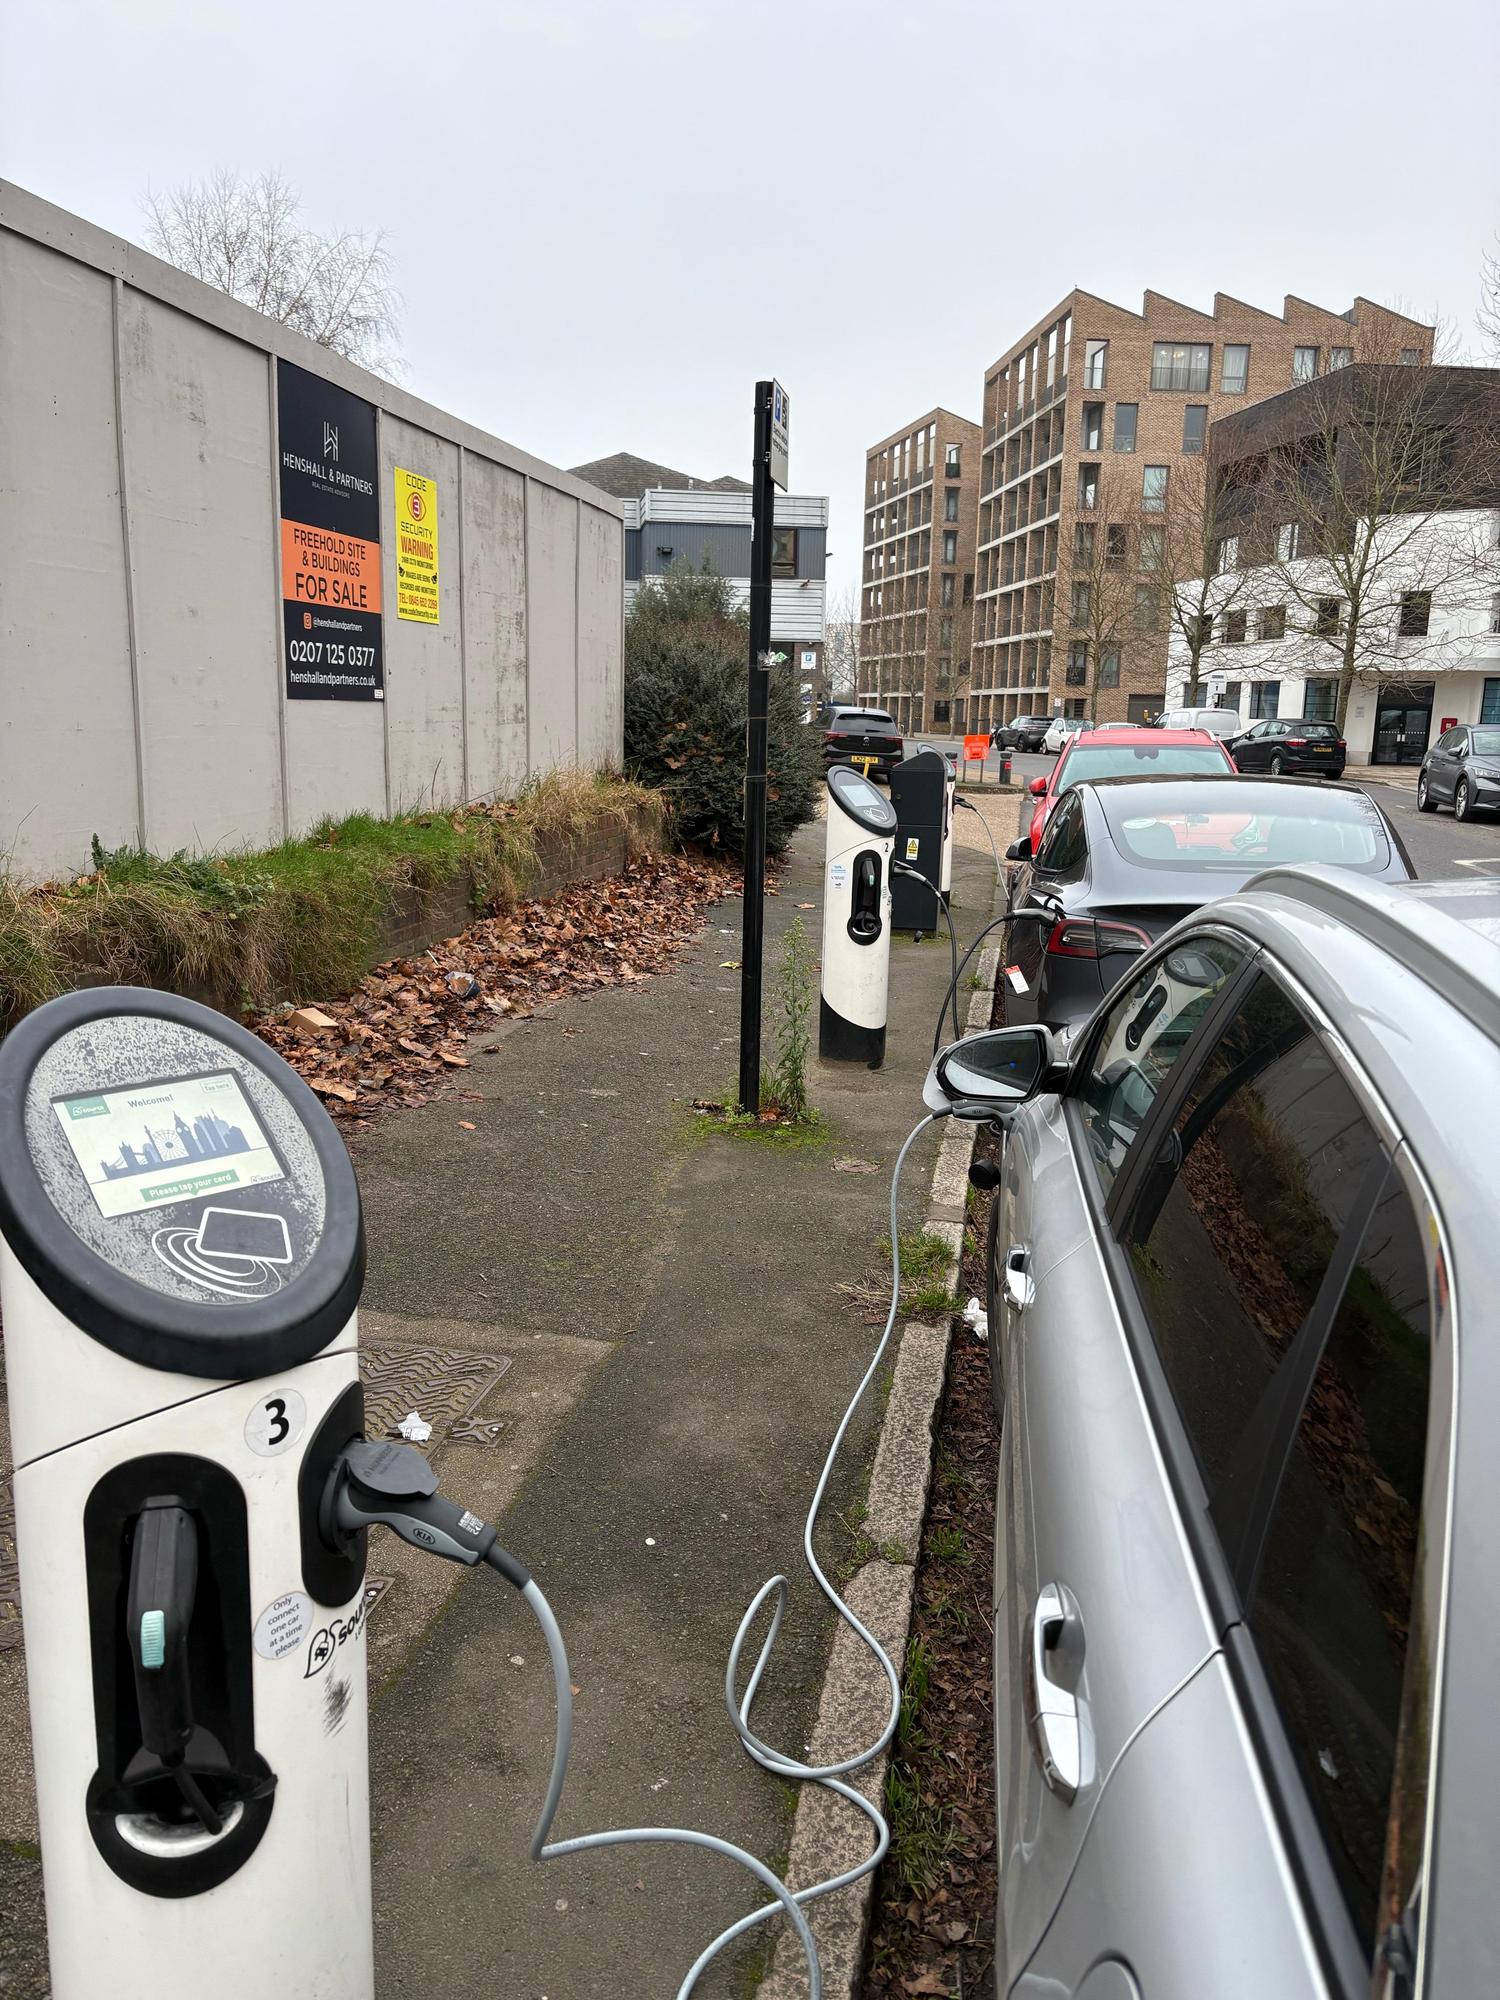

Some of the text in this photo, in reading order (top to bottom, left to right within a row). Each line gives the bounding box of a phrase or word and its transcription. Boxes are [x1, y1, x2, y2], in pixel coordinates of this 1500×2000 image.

[283, 452, 373, 495] HENSHALL & PARTNERS
[406, 474, 427, 492] CODE
[312, 481, 321, 489] REAL
[322, 484, 334, 494] ESTATE
[401, 521, 432, 539] SECURITY
[294, 529, 366, 560] FREEHOLD SITE
[401, 535, 433, 561] WARNING
[302, 551, 360, 577] & BUILDINGS
[295, 572, 367, 608] FOR SALE
[290, 640, 375, 667] 0207 125 0377
[290, 670, 376, 687] henshallandpartners.co.uk
[884, 842, 889, 853] 2
[127, 1093, 174, 1109] Welcome!
[149, 1174, 232, 1198] Please tap your card
[265, 1398, 290, 1446] 3
[416, 1528, 432, 1543] KIA
[267, 1603, 300, 1626] connect
[273, 1596, 292, 1611] Only
[270, 1614, 300, 1635] one car
[269, 1638, 278, 1648] at
[285, 1624, 302, 1639] time
[275, 1636, 300, 1656] please
